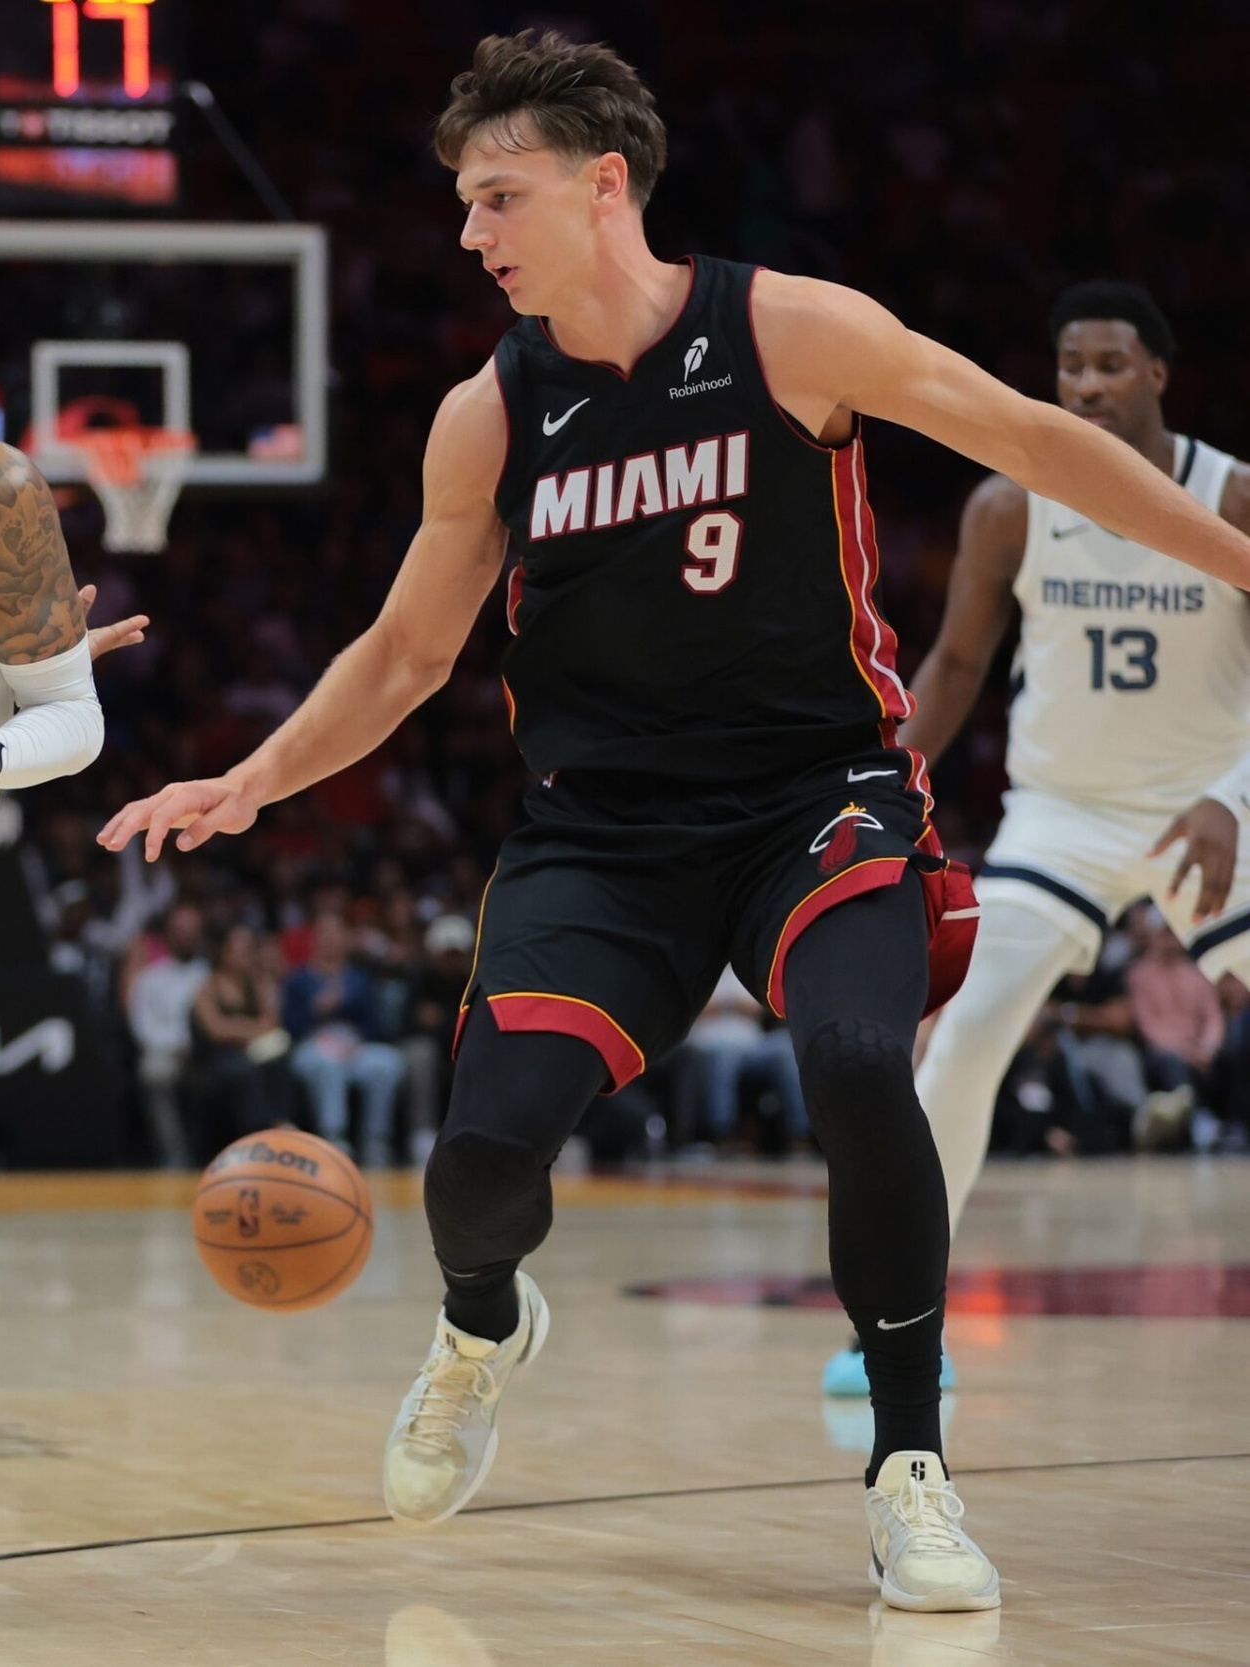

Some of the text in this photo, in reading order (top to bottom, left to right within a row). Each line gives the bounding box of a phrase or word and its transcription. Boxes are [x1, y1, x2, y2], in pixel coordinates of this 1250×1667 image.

[52, 0, 151, 98] 17
[669, 374, 733, 399] Robinhood
[529, 430, 749, 542] MIAMI
[681, 509, 744, 595] 9
[1042, 578, 1205, 613] MEMPHIS
[1085, 627, 1159, 691] 13
